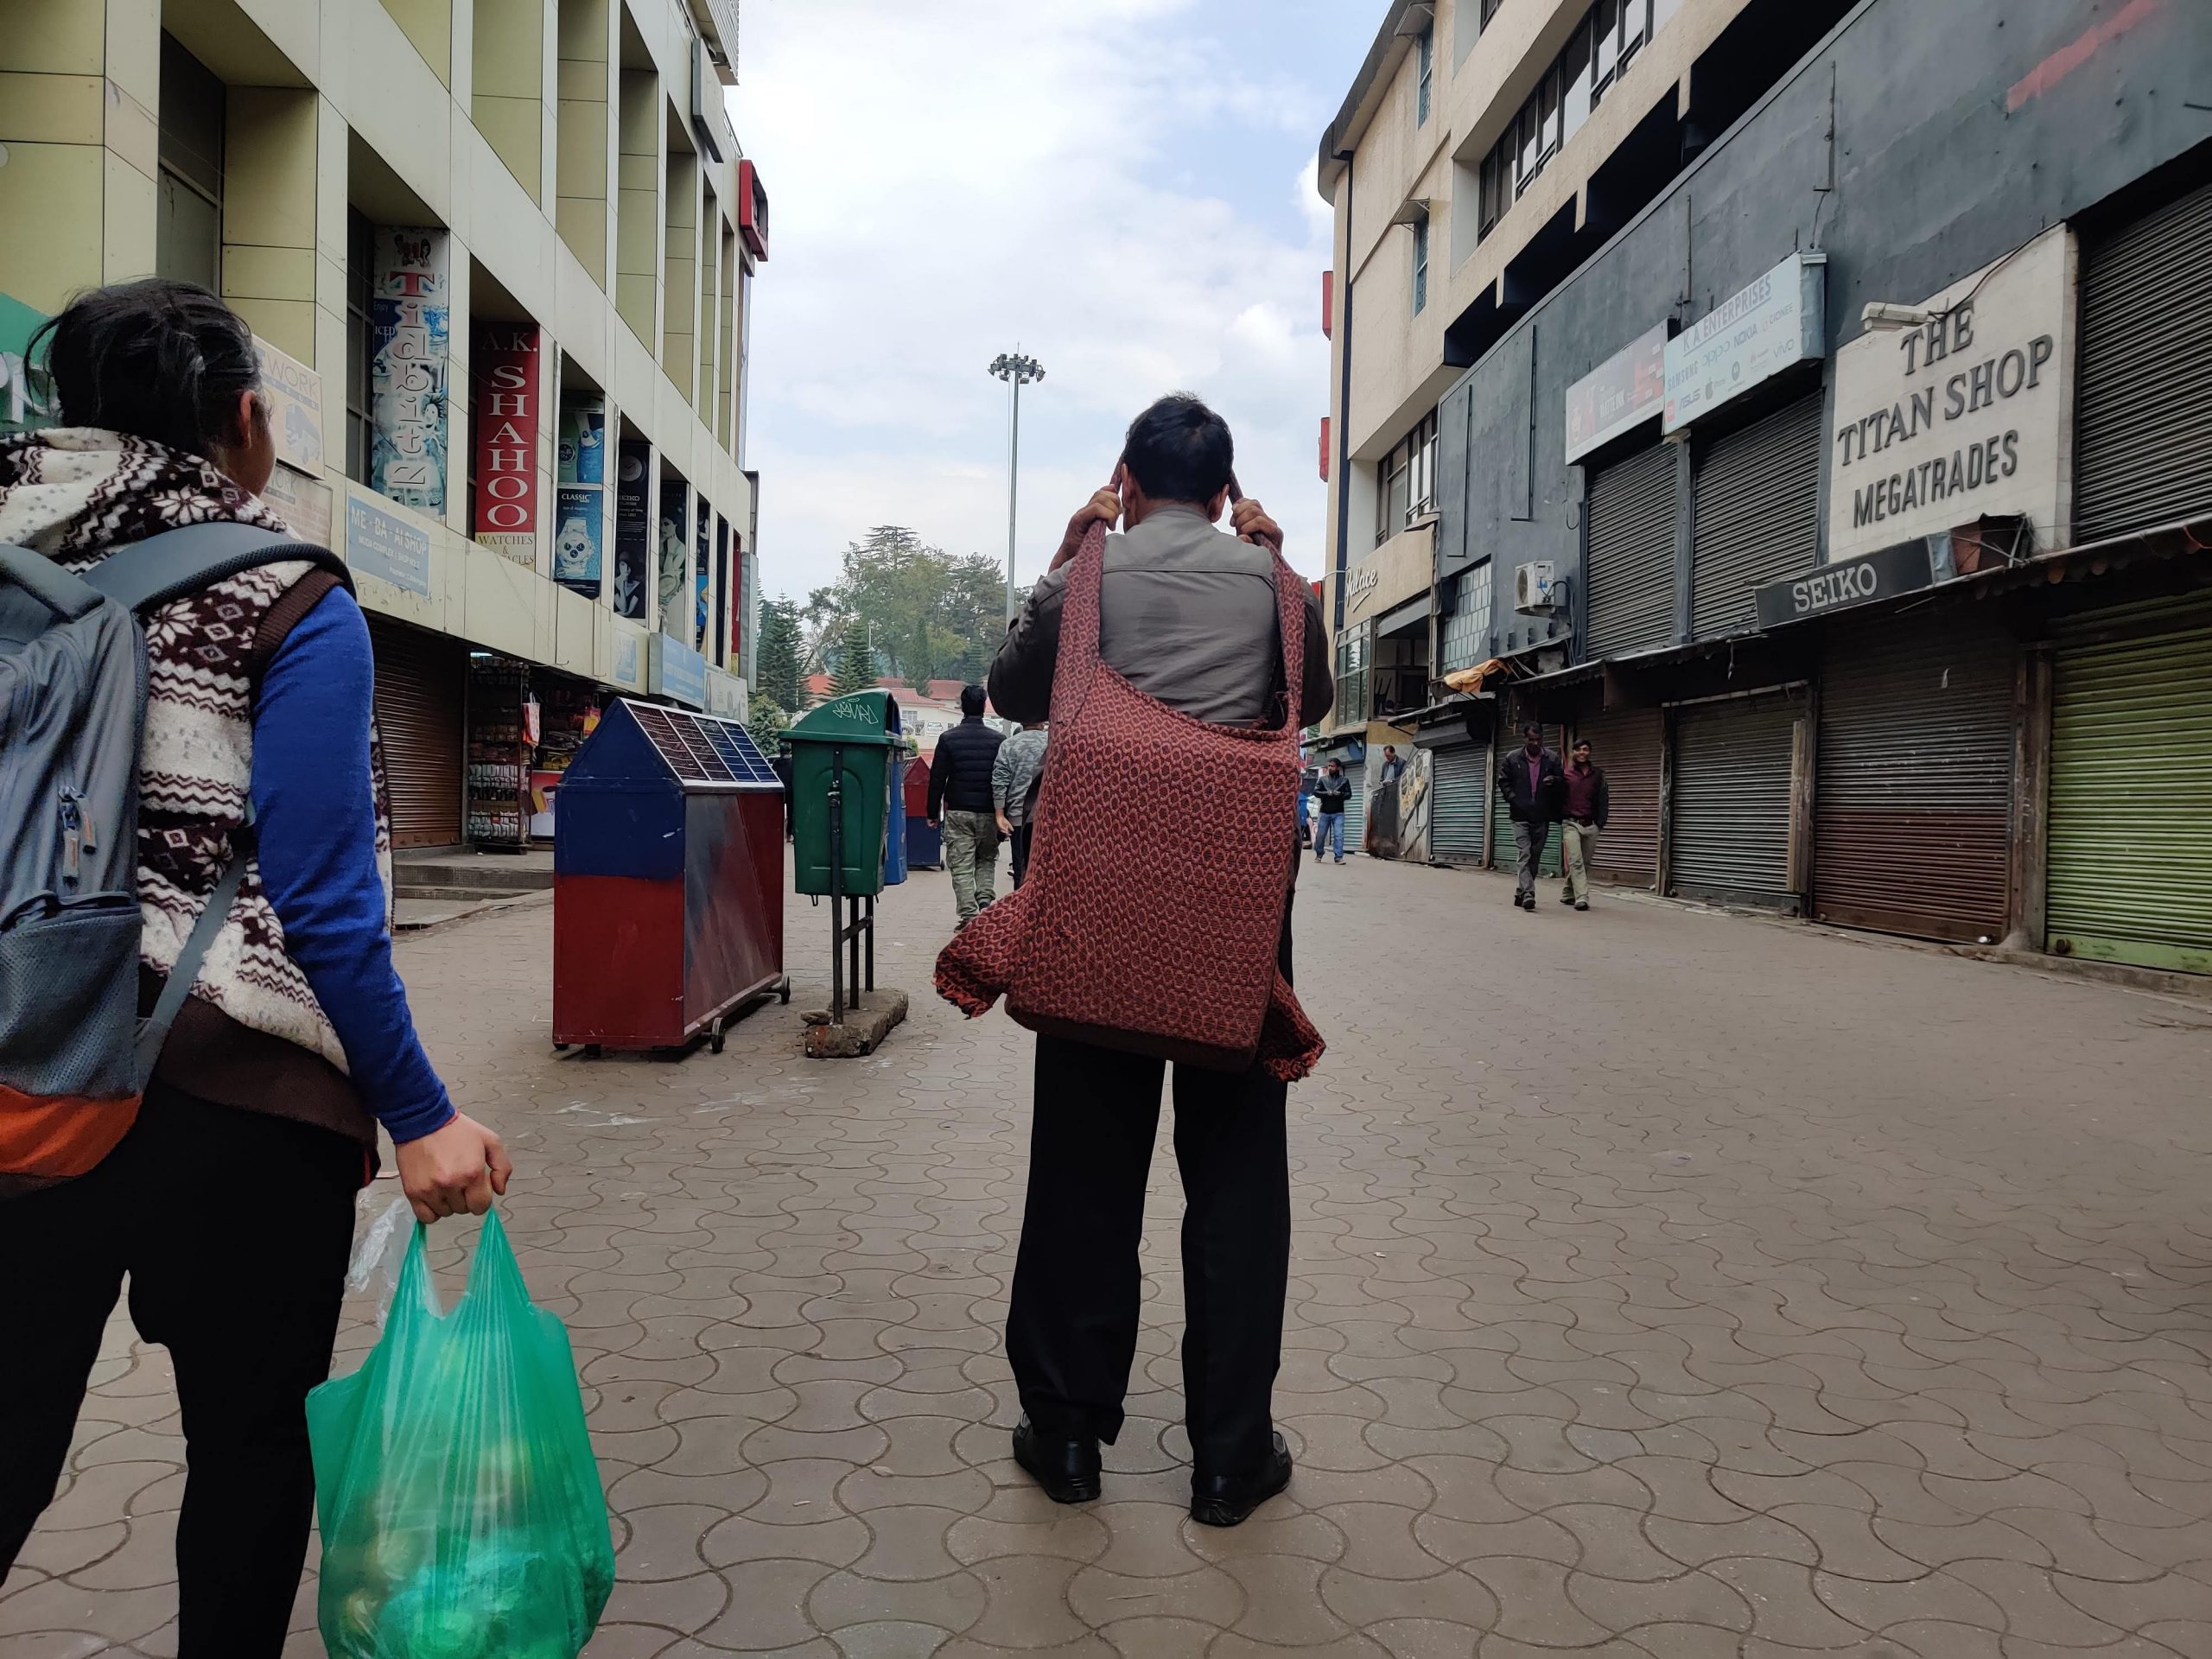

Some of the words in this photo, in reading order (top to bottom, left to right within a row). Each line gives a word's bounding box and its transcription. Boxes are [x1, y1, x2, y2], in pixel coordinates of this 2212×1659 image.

[1703, 274, 1771, 335] ENTERPRISES
[1733, 323, 1758, 347] NOKIA
[1900, 299, 1975, 376] THE
[1837, 385, 1935, 467] TITAN
[1944, 334, 2053, 421] SHOP
[486, 365, 530, 527] SHAHOO
[561, 493, 592, 502] CLASSIC
[1853, 429, 2018, 528] MEGATRADES
[351, 505, 366, 530] ME
[478, 535, 533, 544] WATCHES
[502, 545, 510, 555] &
[1792, 563, 1878, 613] SEIKO
